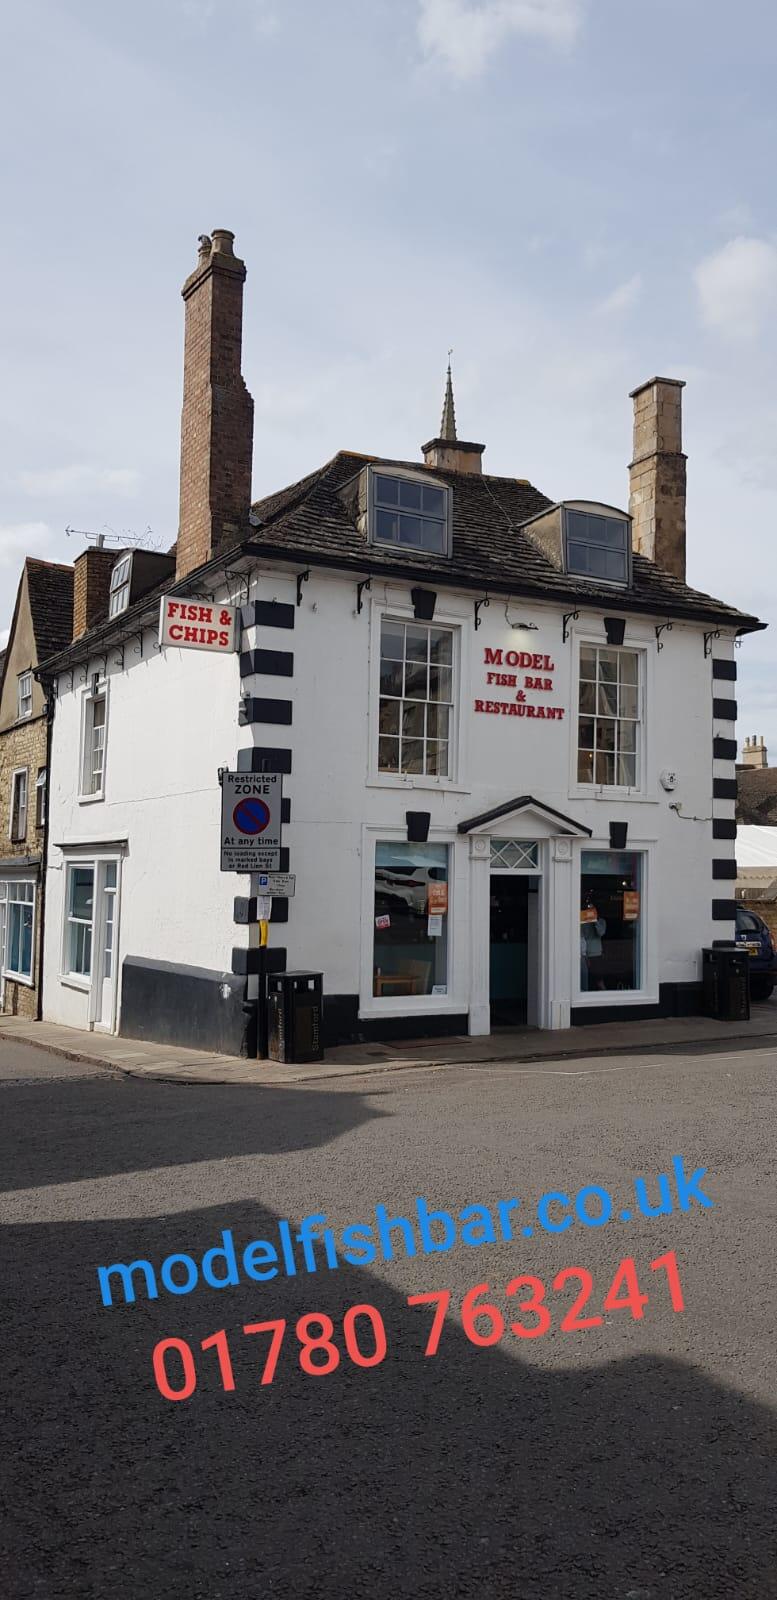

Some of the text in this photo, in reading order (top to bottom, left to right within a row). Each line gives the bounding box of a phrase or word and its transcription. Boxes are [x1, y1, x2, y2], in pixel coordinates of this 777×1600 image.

[167, 602, 232, 626] FISH &
[168, 624, 229, 646] CHIPS
[483, 647, 555, 671] MODEL
[486, 672, 553, 691] FISH BAR
[515, 689, 526, 702] &
[474, 699, 565, 720] RESTAURANT
[227, 774, 277, 783] Restricted
[234, 784, 270, 795] ZONE
[223, 836, 279, 847] At any time
[257, 850, 278, 858] except
